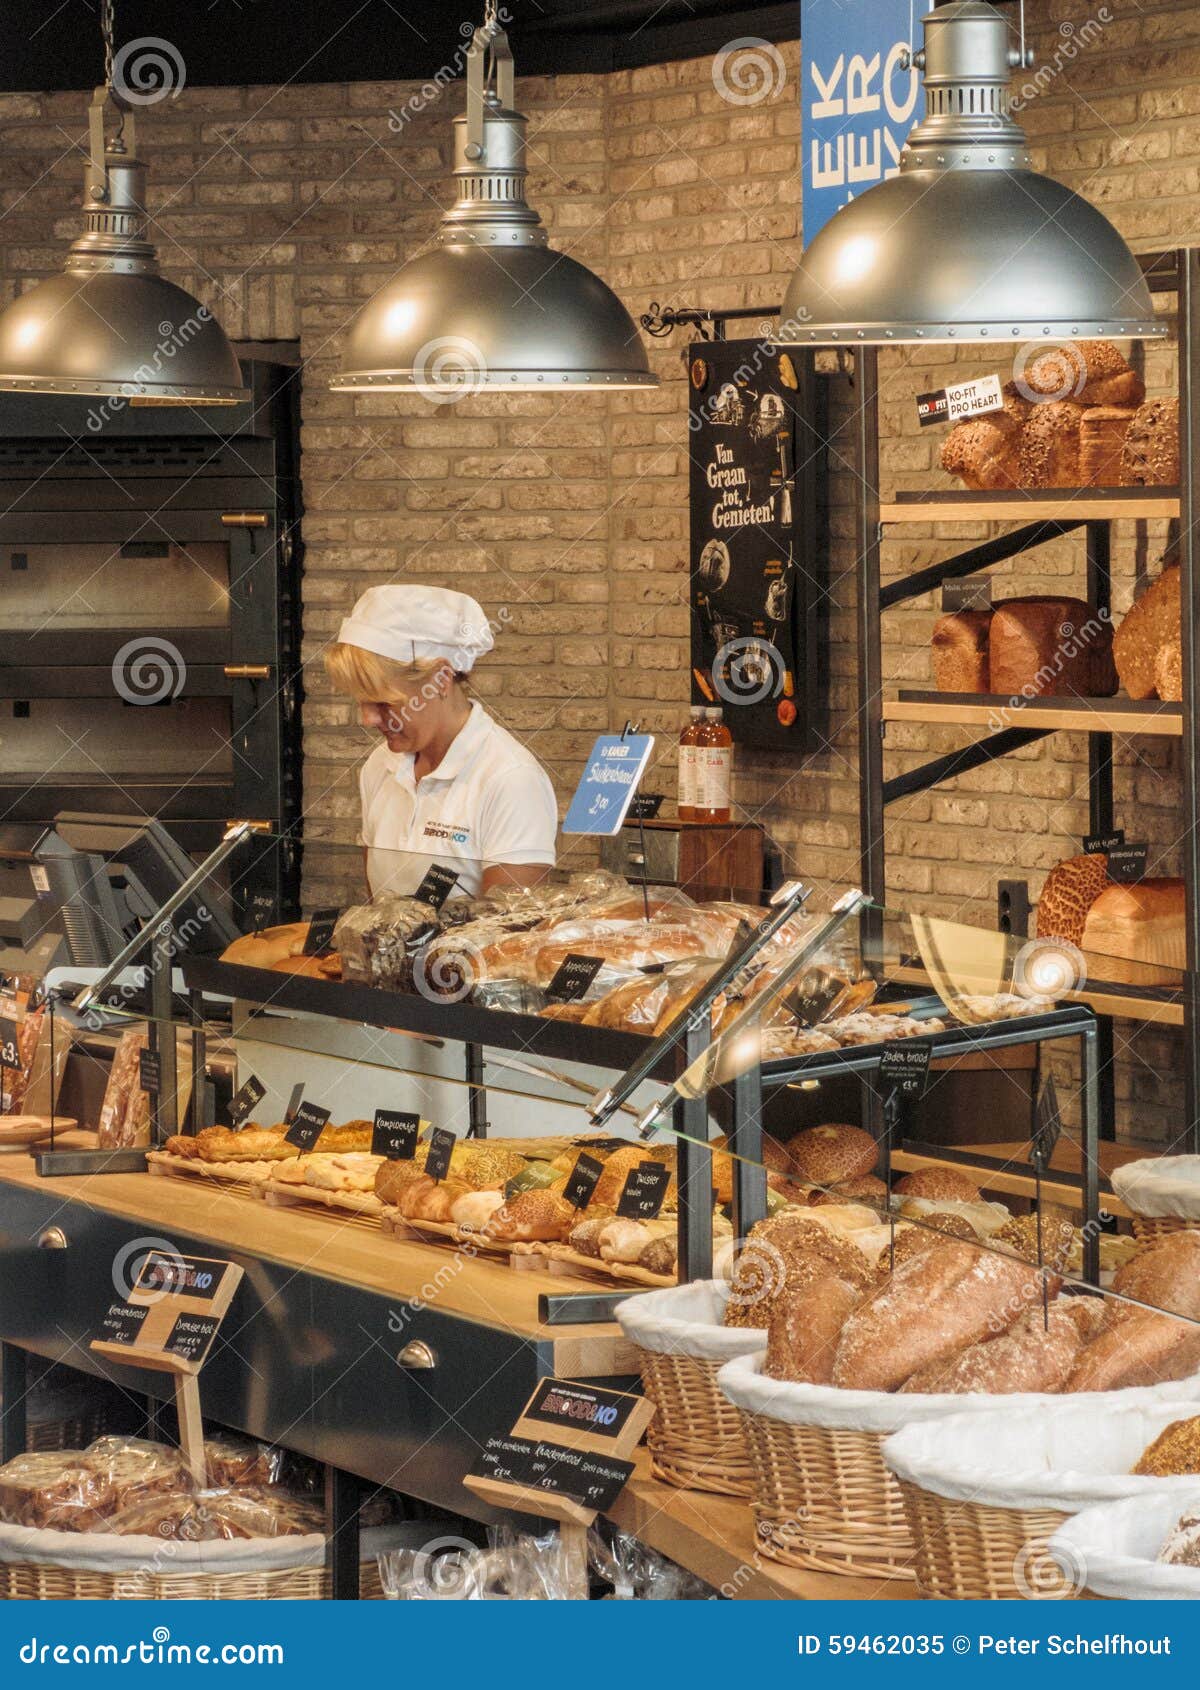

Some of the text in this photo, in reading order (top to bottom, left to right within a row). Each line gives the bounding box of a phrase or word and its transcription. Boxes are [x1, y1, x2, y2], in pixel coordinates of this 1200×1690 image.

[812, 53, 845, 190] EK
[847, 52, 881, 203] ER
[949, 386, 977, 402] KO-FIT
[951, 402, 969, 415] PRO
[971, 394, 998, 410] HEART
[715, 443, 734, 464] Van
[706, 463, 746, 489] Graan
[711, 496, 775, 529] Genieten!
